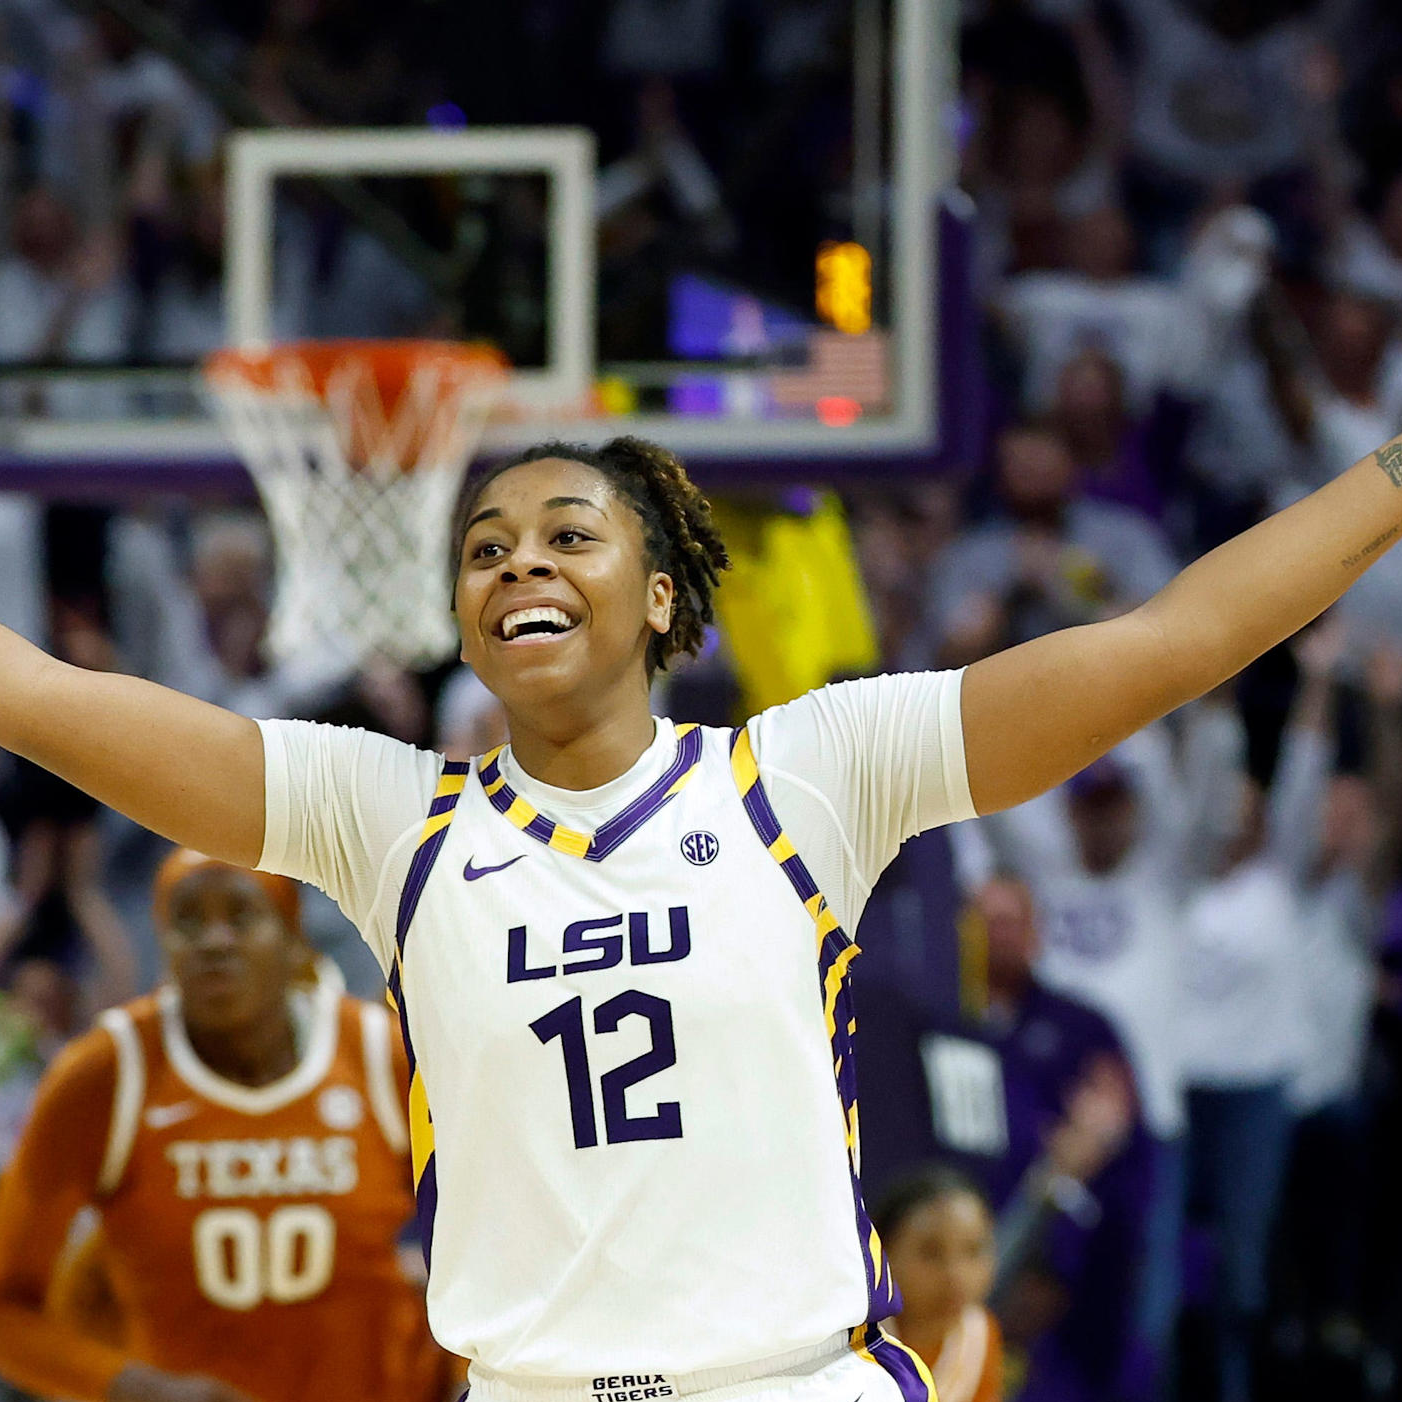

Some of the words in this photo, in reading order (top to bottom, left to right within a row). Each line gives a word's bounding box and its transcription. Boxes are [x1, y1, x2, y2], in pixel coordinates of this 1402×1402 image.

[684, 833, 716, 862] SEC
[507, 905, 691, 983] LSU
[528, 989, 684, 1150] 12
[164, 1136, 360, 1199] TEXAS
[192, 1203, 336, 1312] 00
[592, 1374, 667, 1391] GEAUX
